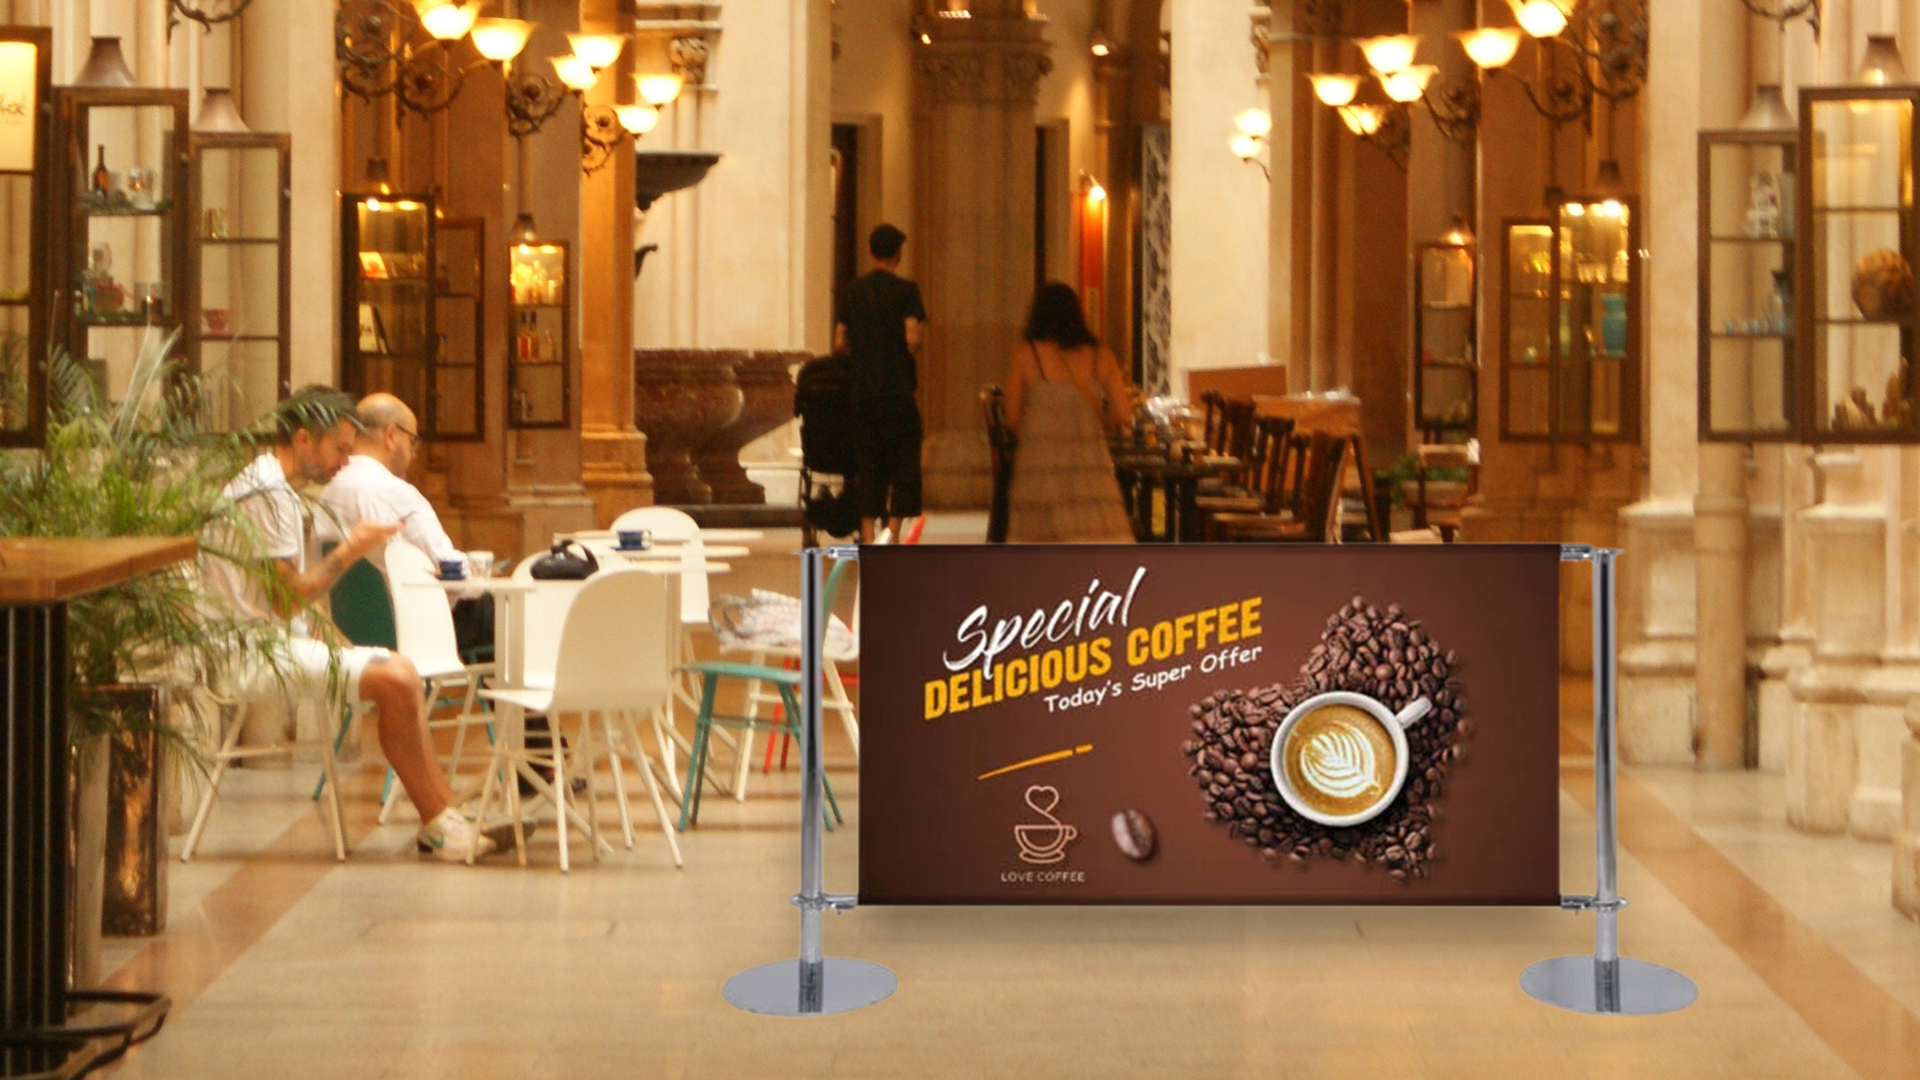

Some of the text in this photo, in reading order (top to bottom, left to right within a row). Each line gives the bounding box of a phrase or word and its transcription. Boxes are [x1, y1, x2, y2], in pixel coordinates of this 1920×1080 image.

[924, 597, 1262, 720] DELICIOUS COFFEE
[943, 566, 1146, 680] Special
[1044, 646, 1262, 713] Today's Super Offer
[1000, 871, 1085, 882] LOVE COFFEE
